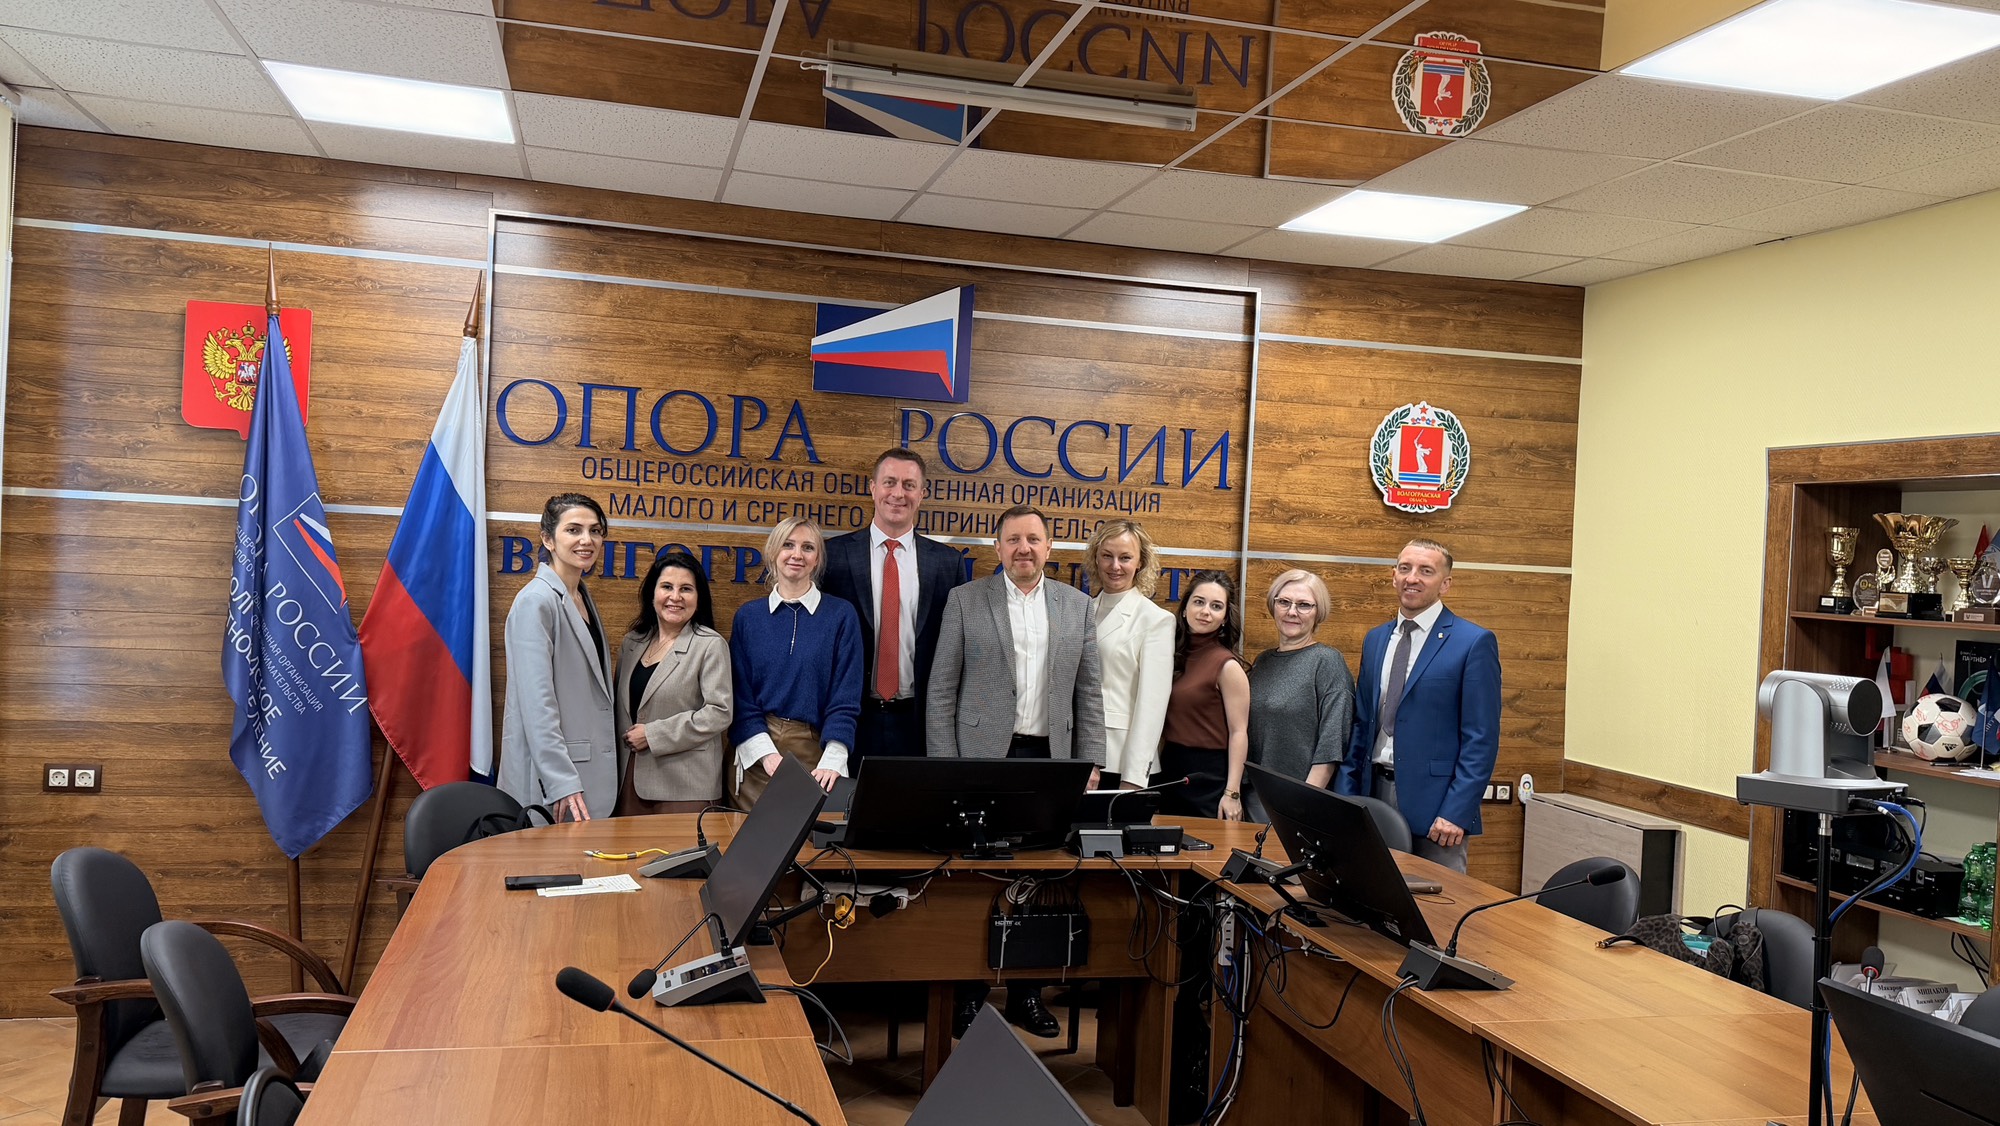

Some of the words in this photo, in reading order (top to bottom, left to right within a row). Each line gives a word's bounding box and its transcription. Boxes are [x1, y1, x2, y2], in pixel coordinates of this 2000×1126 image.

[496, 378, 823, 464] ОПОРА
[900, 407, 1232, 490] РОССИИ
[581, 456, 814, 493] ОБЩЕРОССИЙСКАЯ
[824, 472, 1005, 504] ОБЩВЕННАЯ
[1011, 483, 1161, 516] ОРГАНИЗАЦИЯ
[609, 493, 714, 522] МАЛОГО
[722, 500, 738, 521] И
[747, 500, 864, 529] СРЕДНЕГО
[265, 580, 368, 716] РОССИИ
[279, 654, 324, 713] ОРГАНИЗАЦИЯ
